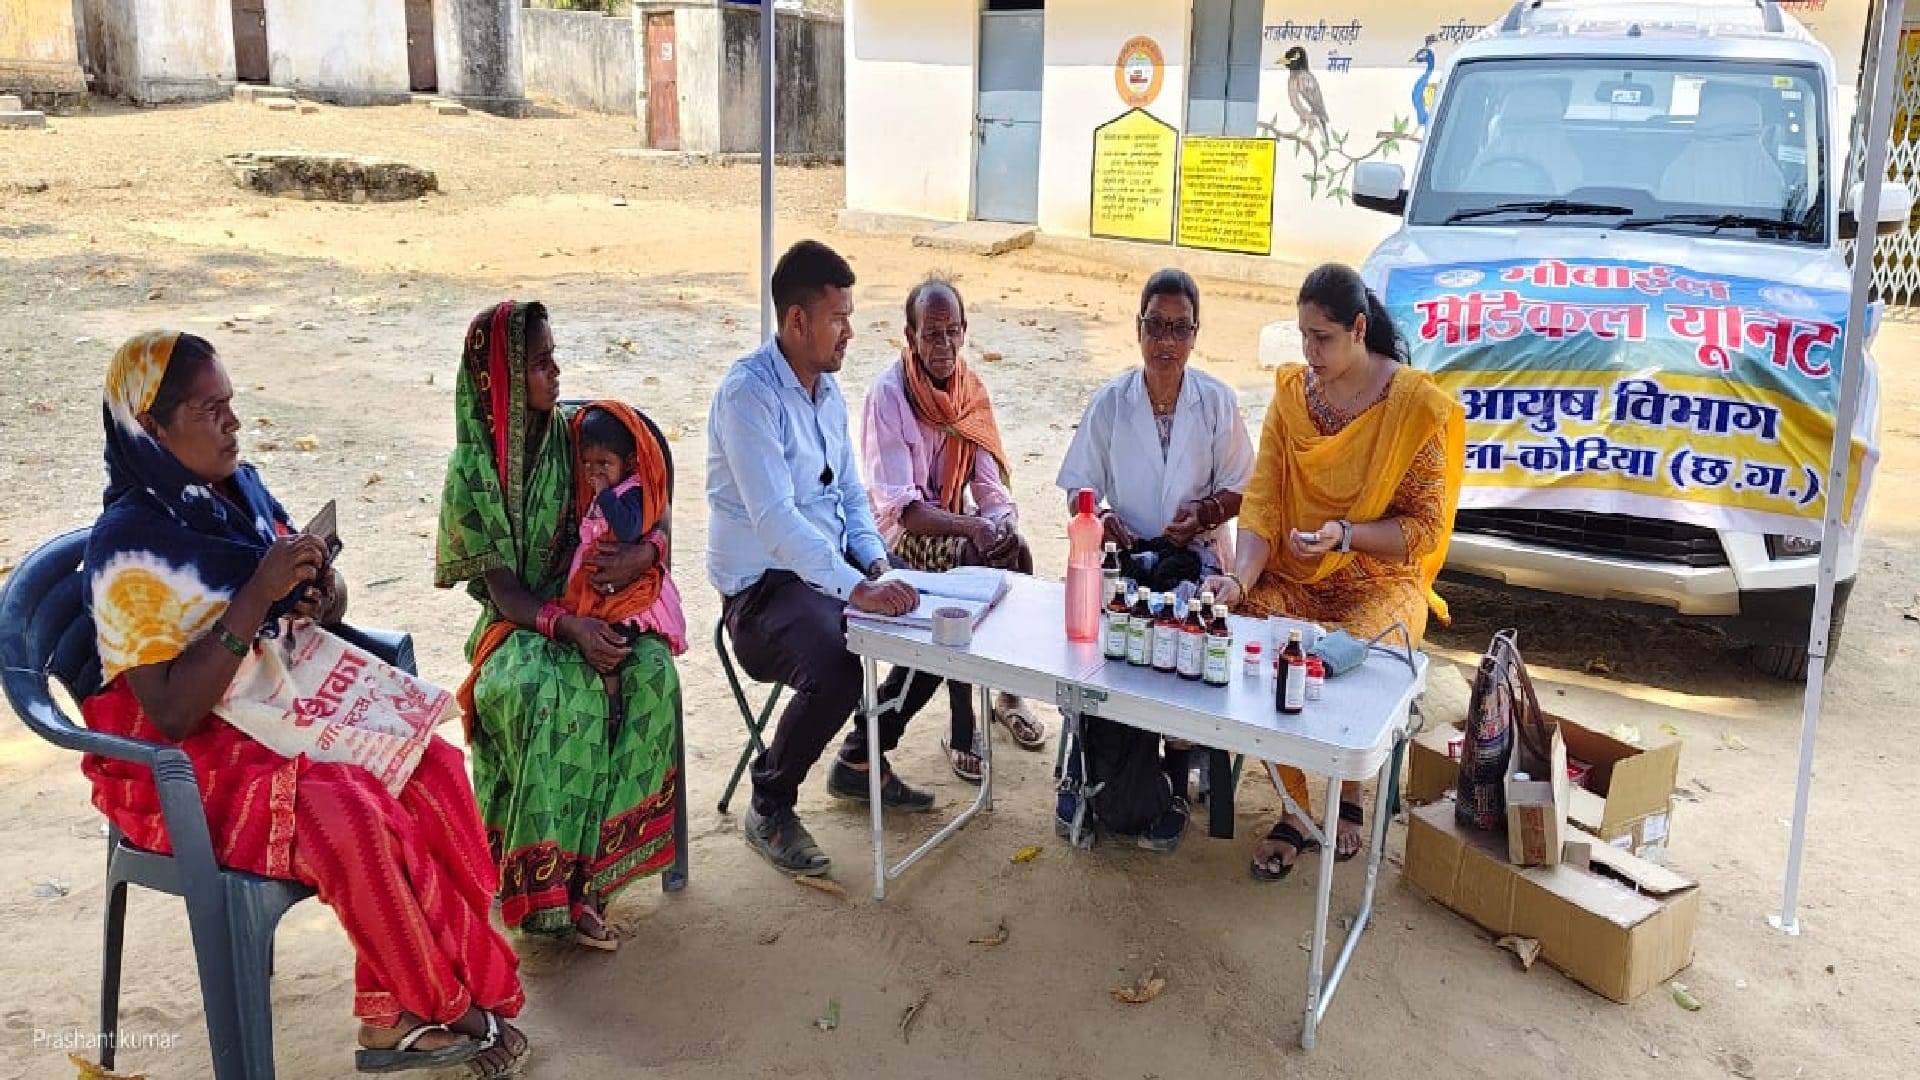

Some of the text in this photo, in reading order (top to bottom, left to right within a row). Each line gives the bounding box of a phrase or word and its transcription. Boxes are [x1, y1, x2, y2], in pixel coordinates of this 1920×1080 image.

[1463, 380, 1779, 440] आयुष विभाग
[1671, 450, 1820, 504] (छ.ग.)
